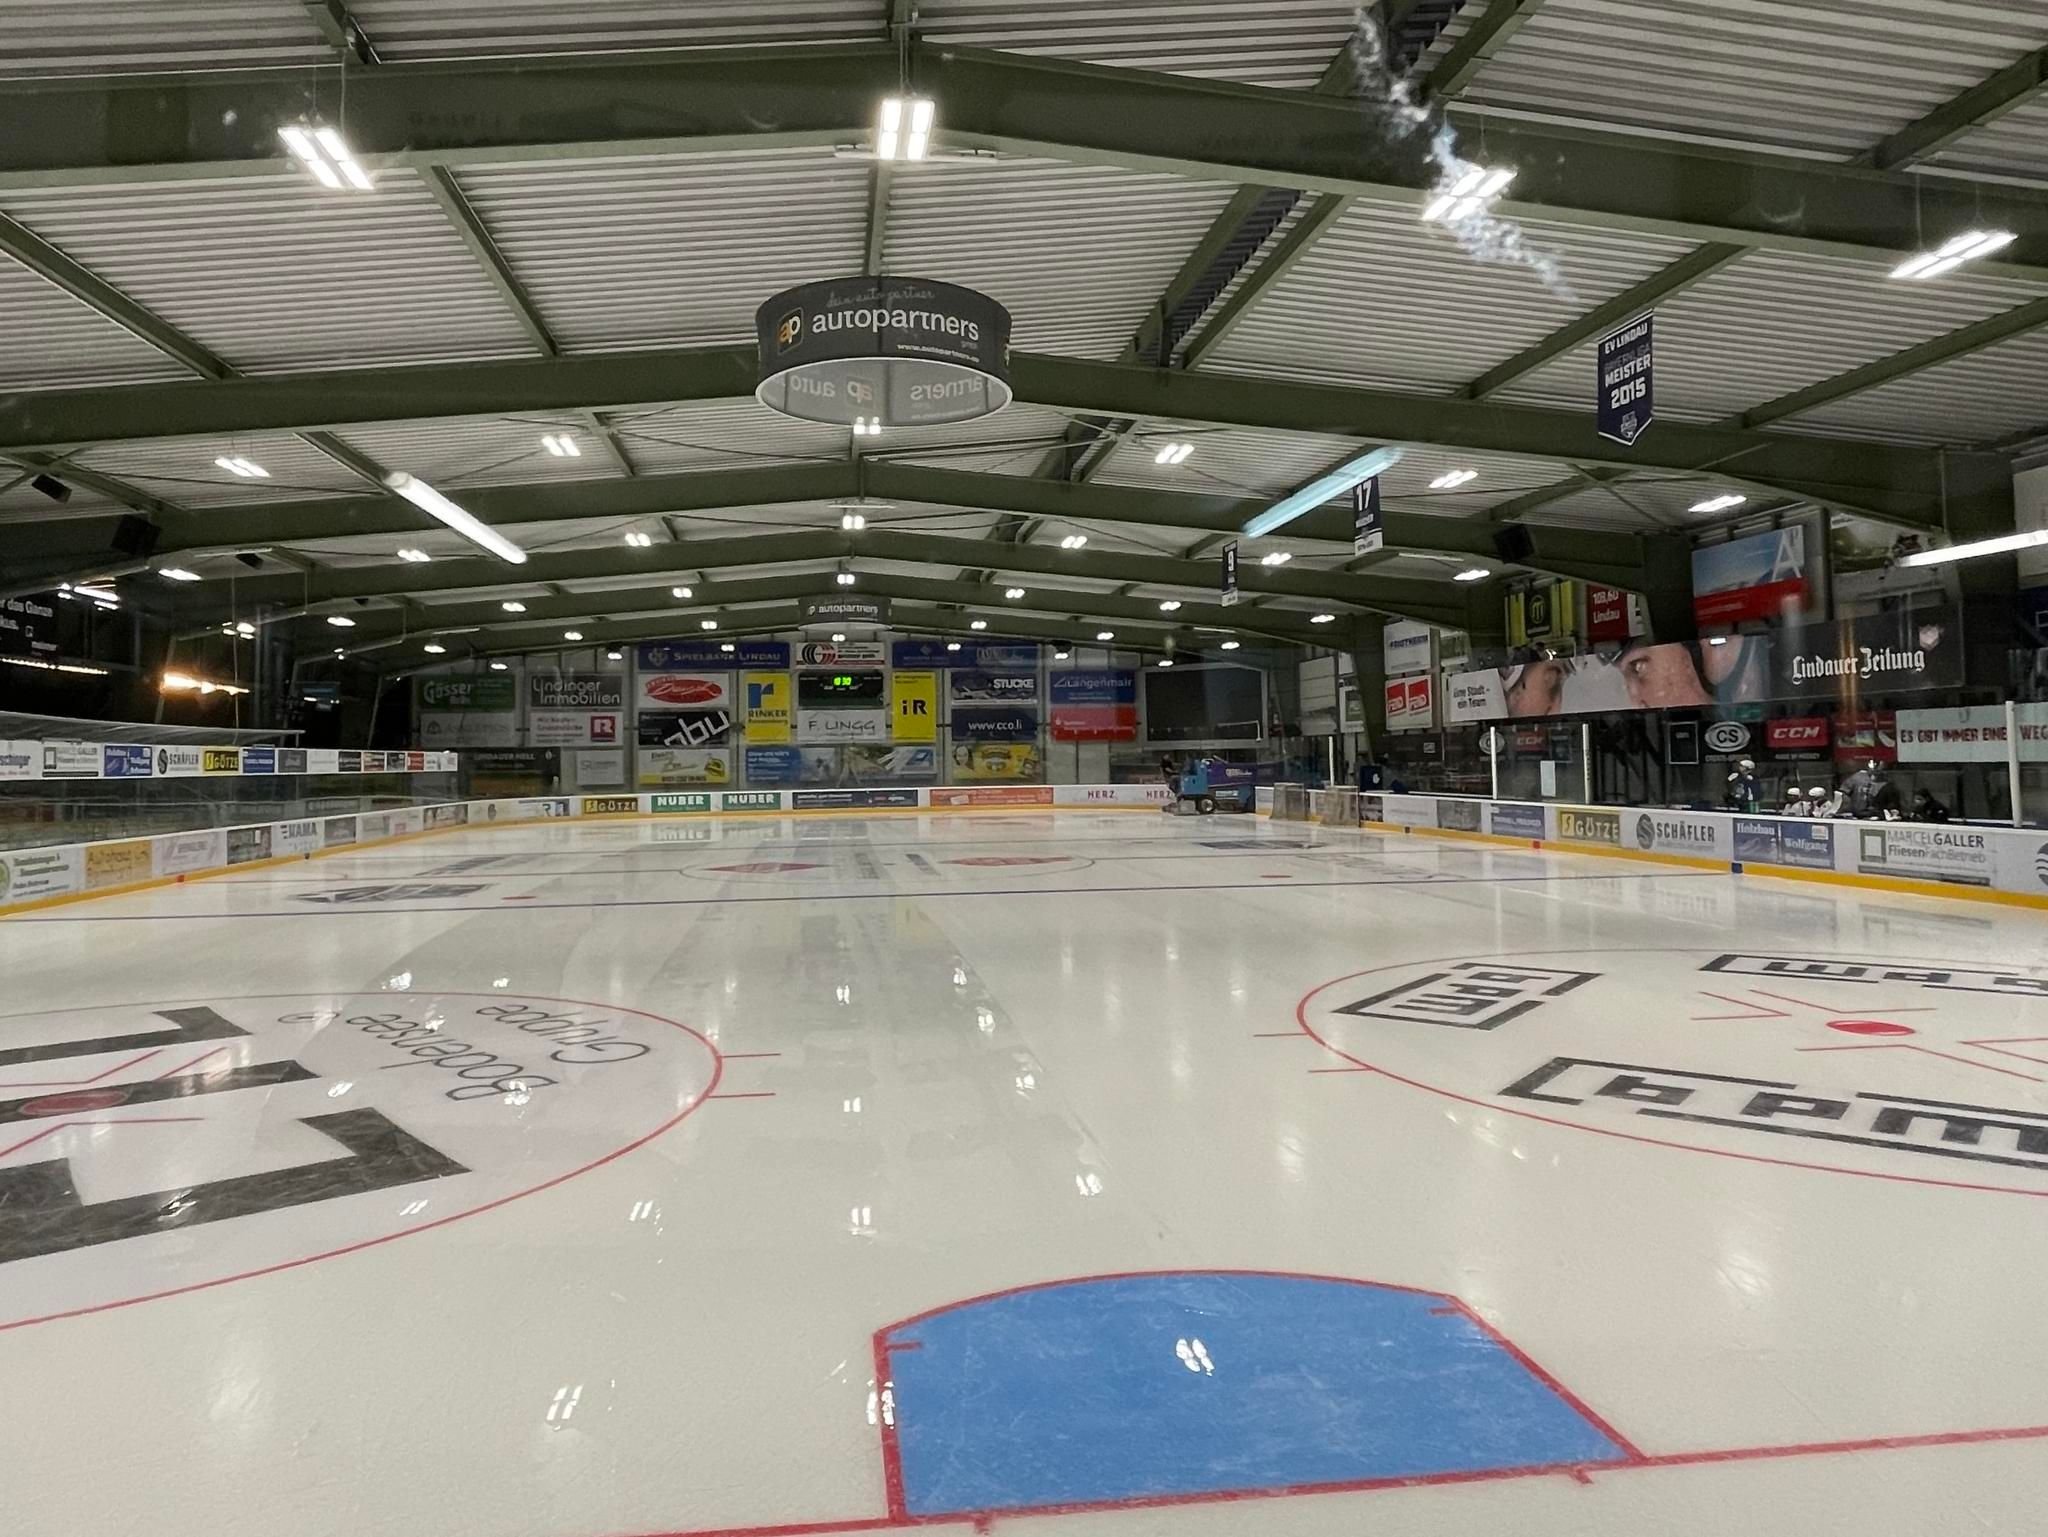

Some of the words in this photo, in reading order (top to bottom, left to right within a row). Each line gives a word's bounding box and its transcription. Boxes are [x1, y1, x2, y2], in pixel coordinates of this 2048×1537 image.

[812, 308, 979, 341] autopartners
[1604, 341, 1616, 355] EV
[1617, 322, 1648, 349] LINDAU
[1605, 354, 1651, 388] MEISTER
[1611, 377, 1646, 409] 2015
[1356, 480, 1372, 512] 17
[818, 604, 879, 615] autopartners
[1792, 654, 1858, 685] Lindauer
[1860, 647, 1925, 681] Zeitung
[540, 690, 620, 705] Immobilien
[750, 709, 788, 718] RINKER
[968, 719, 1022, 731] www.cco.li
[1773, 726, 1820, 739] CCM
[1716, 729, 1739, 744] CS
[1901, 730, 1913, 743] ES
[1088, 789, 1115, 800] HERZ
[1656, 820, 1715, 843] SCHÄFLER
